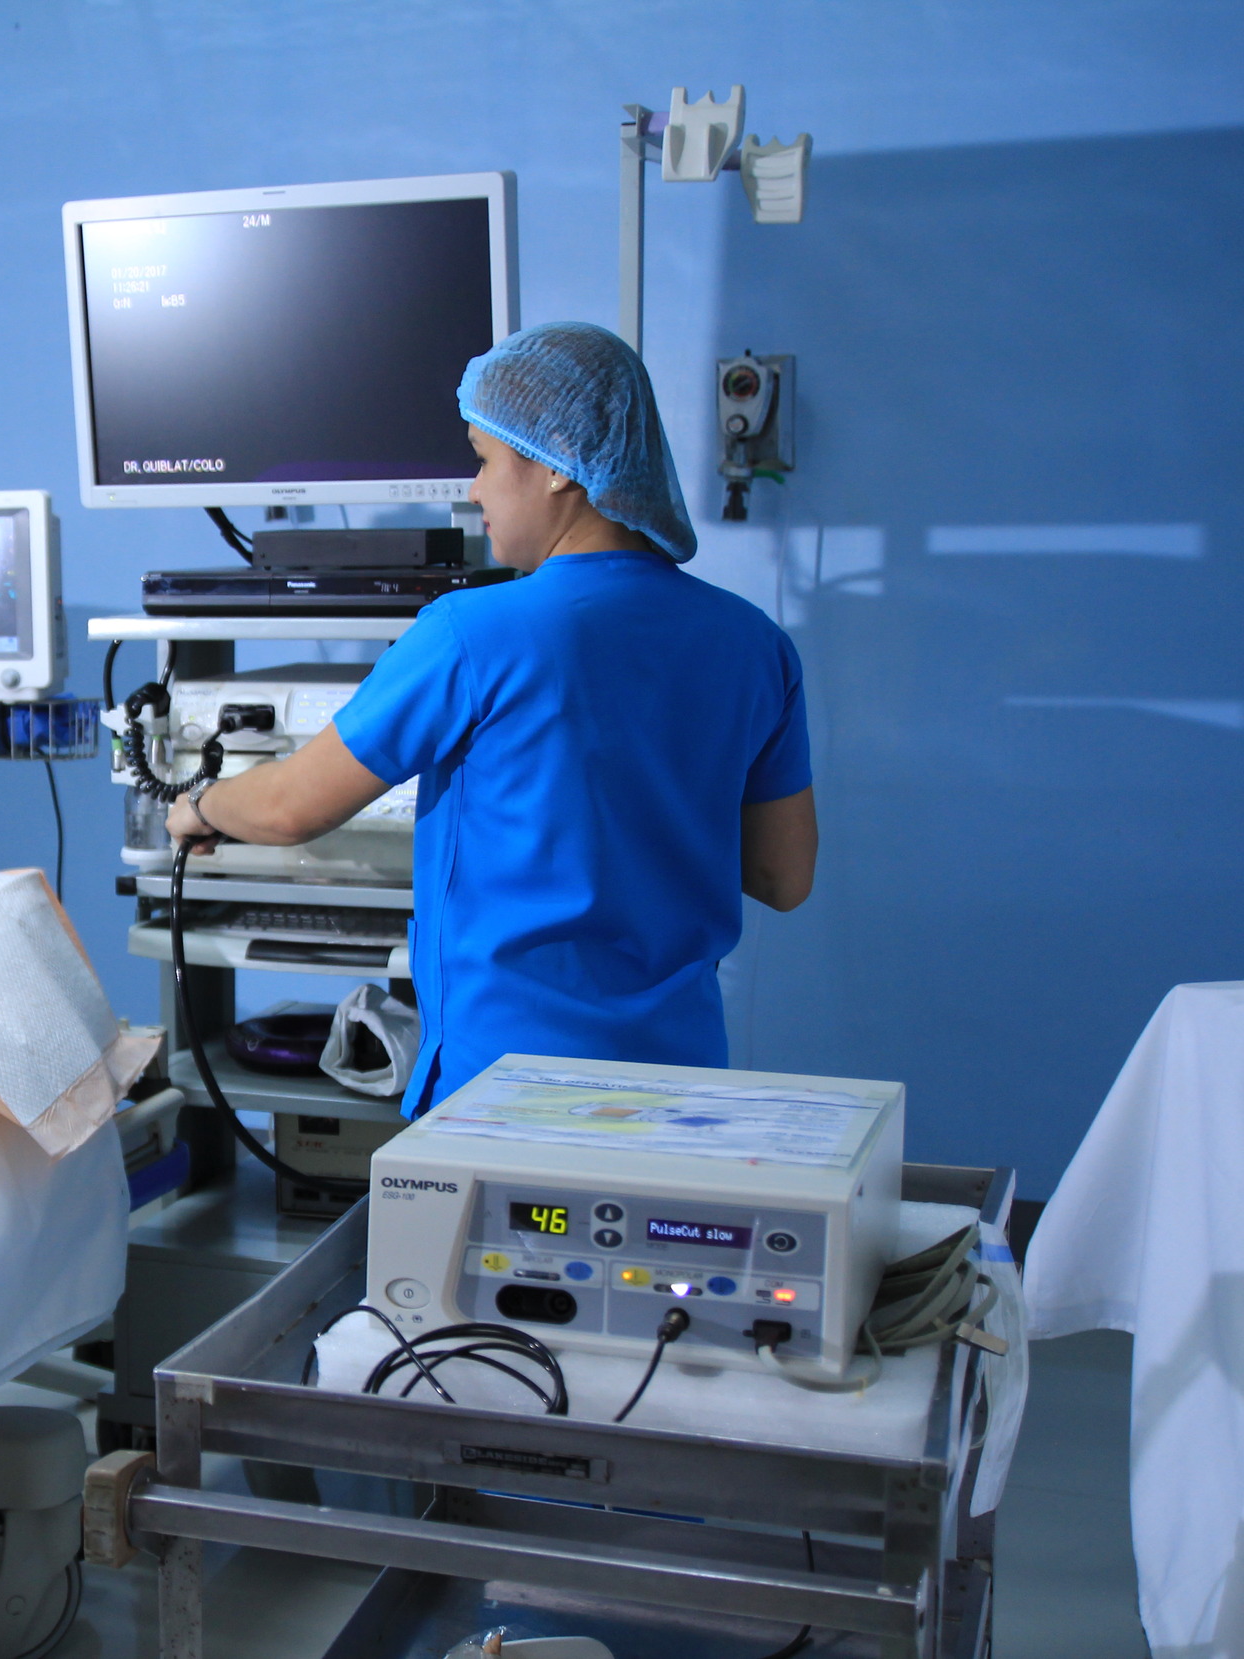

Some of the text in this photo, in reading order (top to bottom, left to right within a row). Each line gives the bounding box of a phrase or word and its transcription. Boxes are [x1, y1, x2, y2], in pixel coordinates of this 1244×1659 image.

[243, 214, 270, 228] 24/M
[123, 459, 225, 473] DR. QUIBLAT/COLO
[381, 1177, 458, 1193] OLYMPUS
[382, 1190, 416, 1201] ESG-100
[531, 1206, 568, 1234] 46
[650, 1222, 733, 1241] PulseCut slow
